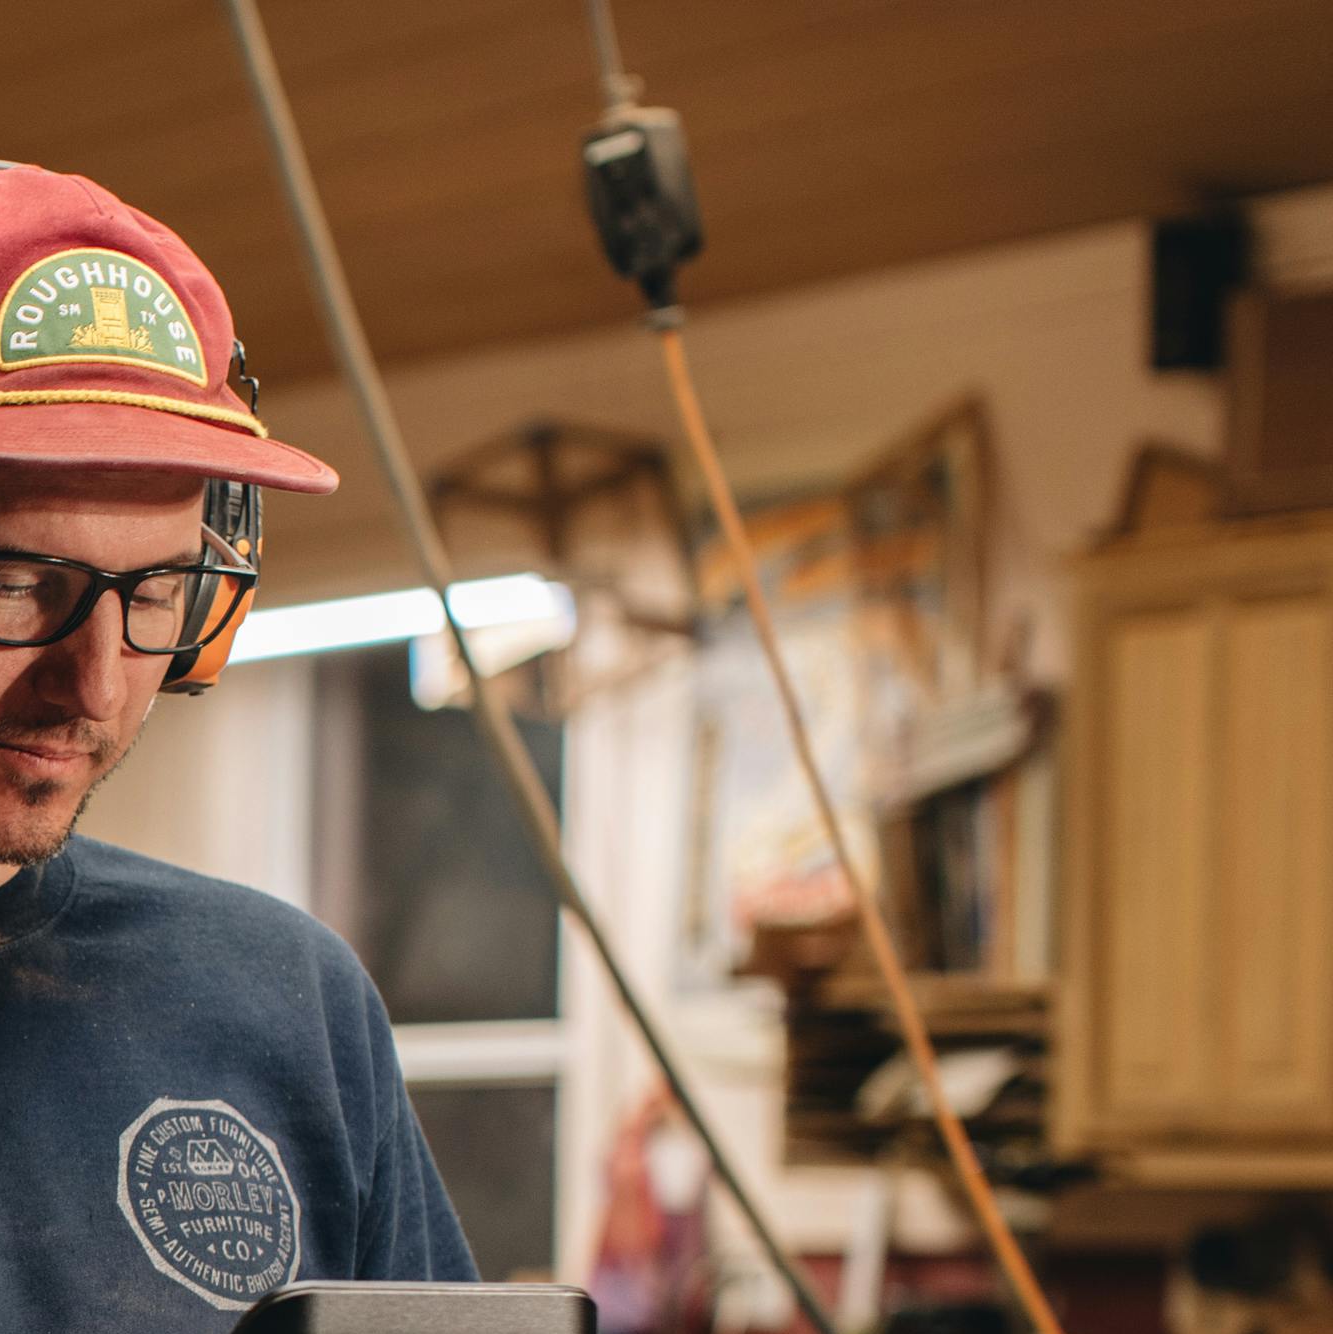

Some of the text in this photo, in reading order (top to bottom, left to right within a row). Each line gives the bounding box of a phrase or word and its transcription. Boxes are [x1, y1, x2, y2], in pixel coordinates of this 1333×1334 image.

[9, 262, 196, 364] ROUGHHOUSE
[59, 303, 158, 325] SM TX
[135, 1116, 279, 1185] FINE CUSTOM FURNITURE
[162, 1162, 187, 1174] EST.
[168, 1180, 272, 1215] MORLEY
[180, 1215, 273, 1243] FURNITURE
[139, 1198, 292, 1294] SEMI-AUTHENTIC BRITISH ACCENT
[221, 1240, 255, 1262] CO.
